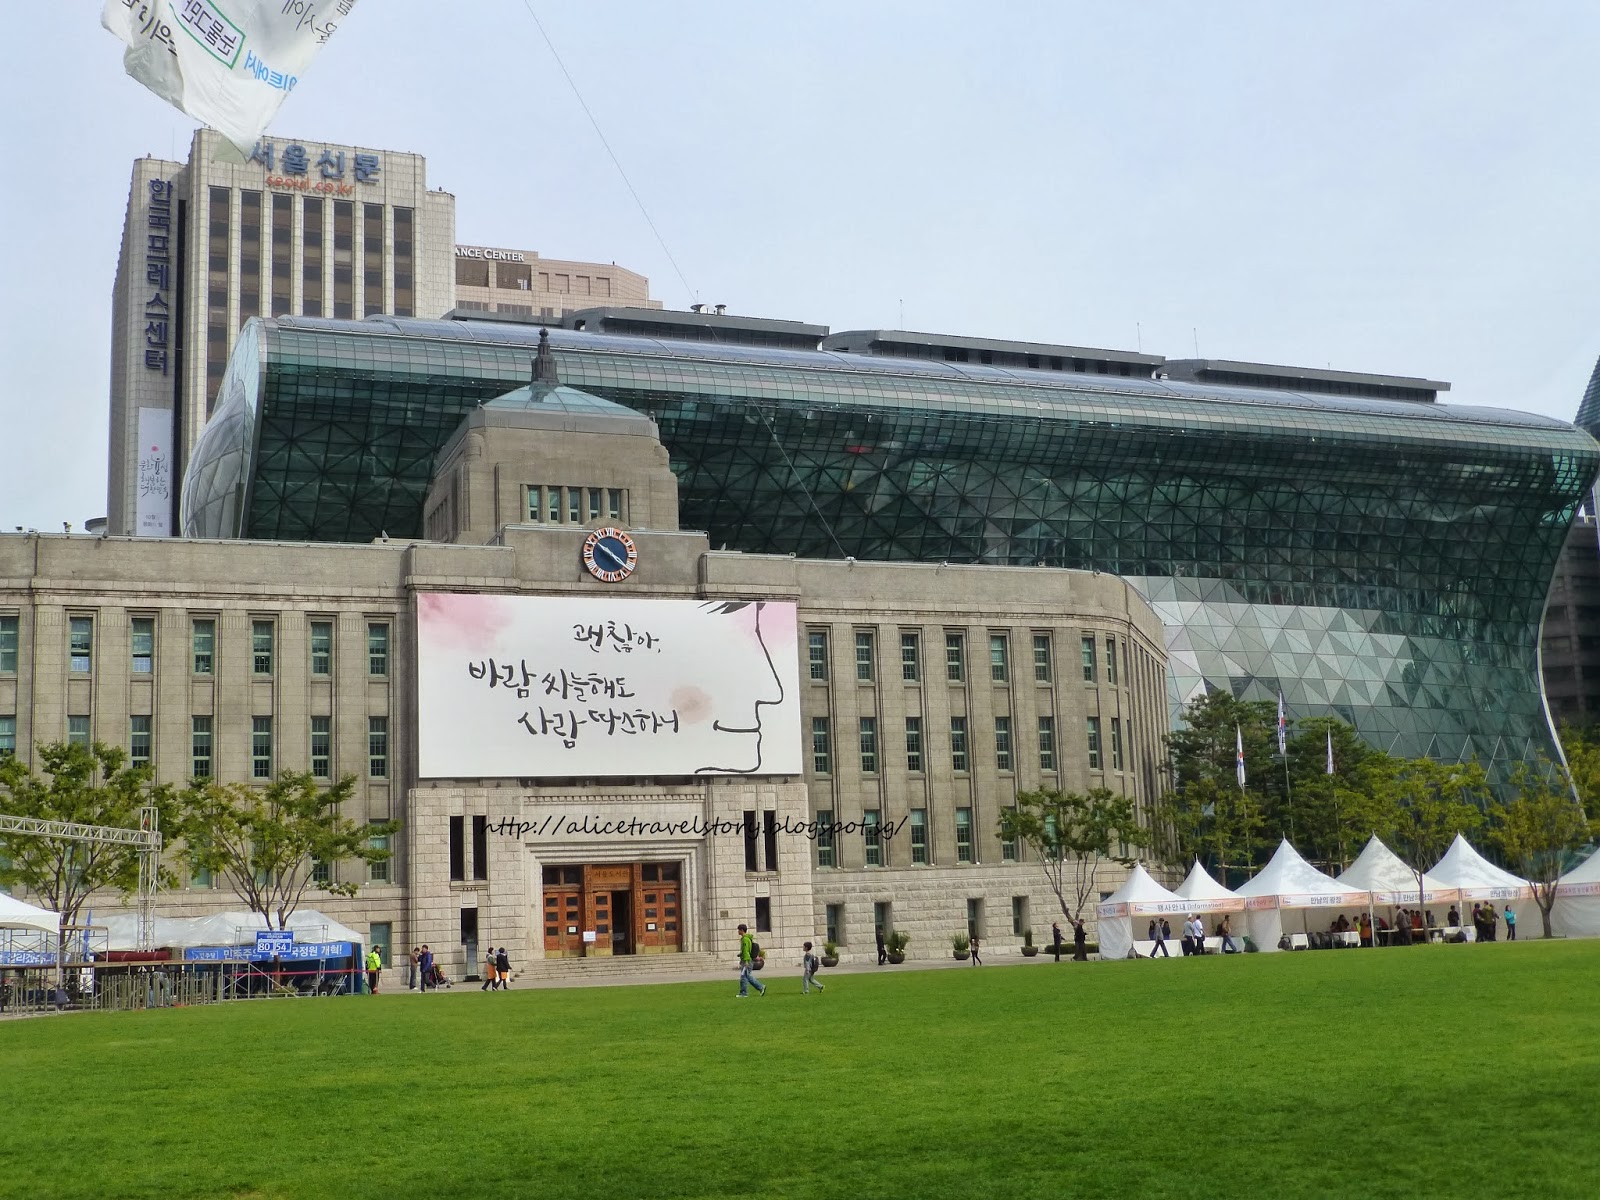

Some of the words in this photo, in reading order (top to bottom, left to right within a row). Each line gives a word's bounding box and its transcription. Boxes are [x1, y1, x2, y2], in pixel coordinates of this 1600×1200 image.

[246, 142, 381, 184] 서울신문
[266, 176, 355, 195] seoul.co.kr
[484, 248, 525, 261] CENTER
[145, 178, 173, 376] 한국프레스센터
[573, 620, 662, 654] 괜찮아,
[468, 658, 537, 699] 바람
[542, 669, 636, 702] 싸늘해도
[518, 706, 588, 749] 사람
[588, 708, 679, 735] 따스하니
[259, 942, 270, 950] 80
[276, 942, 286, 951] 54
